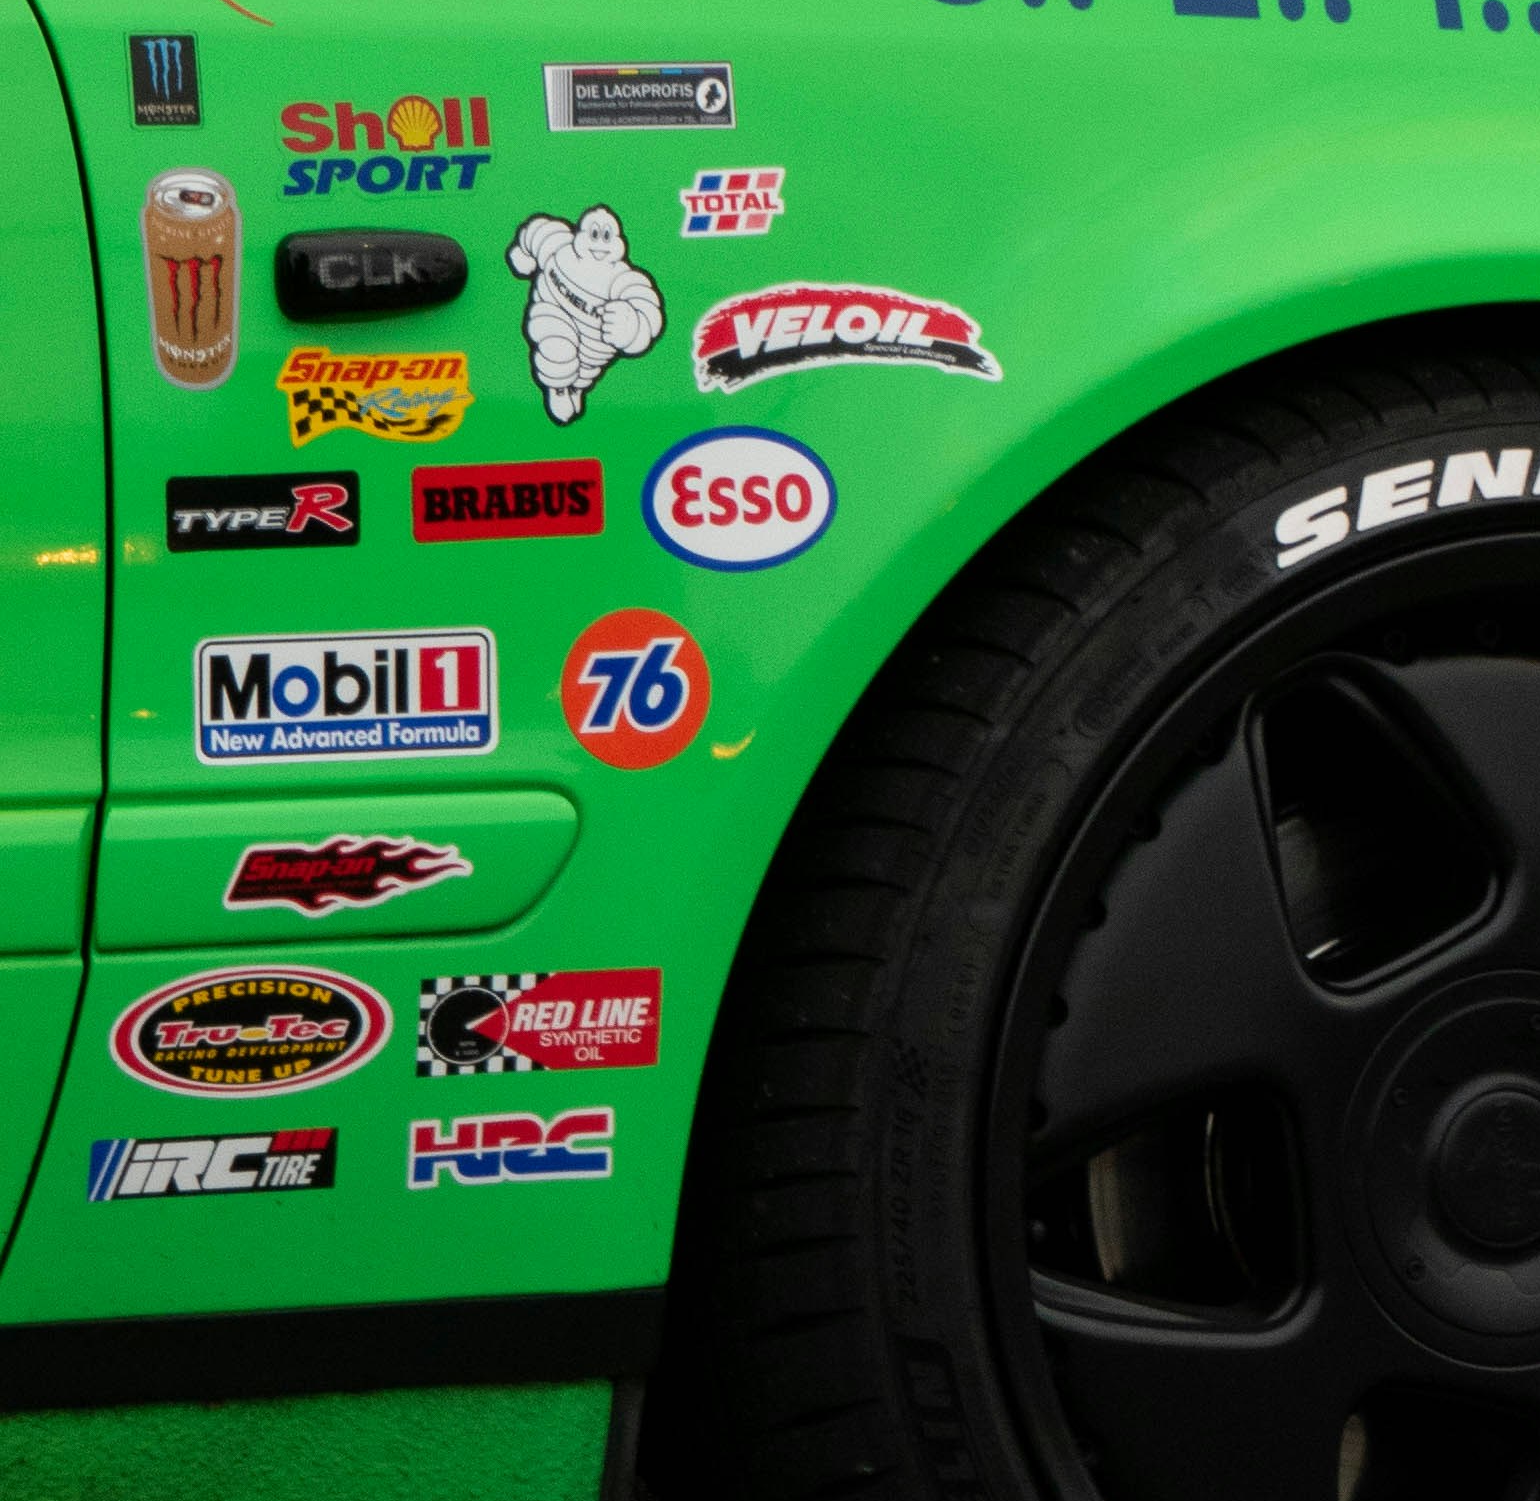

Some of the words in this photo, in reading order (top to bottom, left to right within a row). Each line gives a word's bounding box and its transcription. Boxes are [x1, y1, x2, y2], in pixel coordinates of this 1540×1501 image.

[575, 84, 601, 100] DIE
[603, 82, 694, 100] LACKPROFIS
[283, 153, 491, 197] SPORT
[685, 189, 780, 216] TOTAL
[732, 303, 937, 360] VELOIL
[282, 351, 463, 389] Snap-on
[173, 505, 290, 533] TYPE
[422, 481, 593, 524] BRABUS
[209, 646, 409, 722] Mobil
[580, 637, 690, 734] 76
[209, 729, 265, 752] New
[270, 722, 382, 751] Advanced
[389, 719, 480, 746] Formula
[244, 854, 377, 884] Snap-on
[172, 980, 334, 1013] PRECISION
[510, 1000, 576, 1032] RED
[579, 997, 653, 1029] LINE
[154, 1049, 218, 1063] RACING
[226, 1041, 347, 1059] DEVELOPMENT
[539, 1028, 643, 1048] SYNTHETIC
[574, 1047, 605, 1062] OIL
[190, 1066, 262, 1084] TUNE
[273, 1059, 312, 1079] UP
[411, 1111, 609, 1184] HRC
[258, 1153, 322, 1187] TIRE
